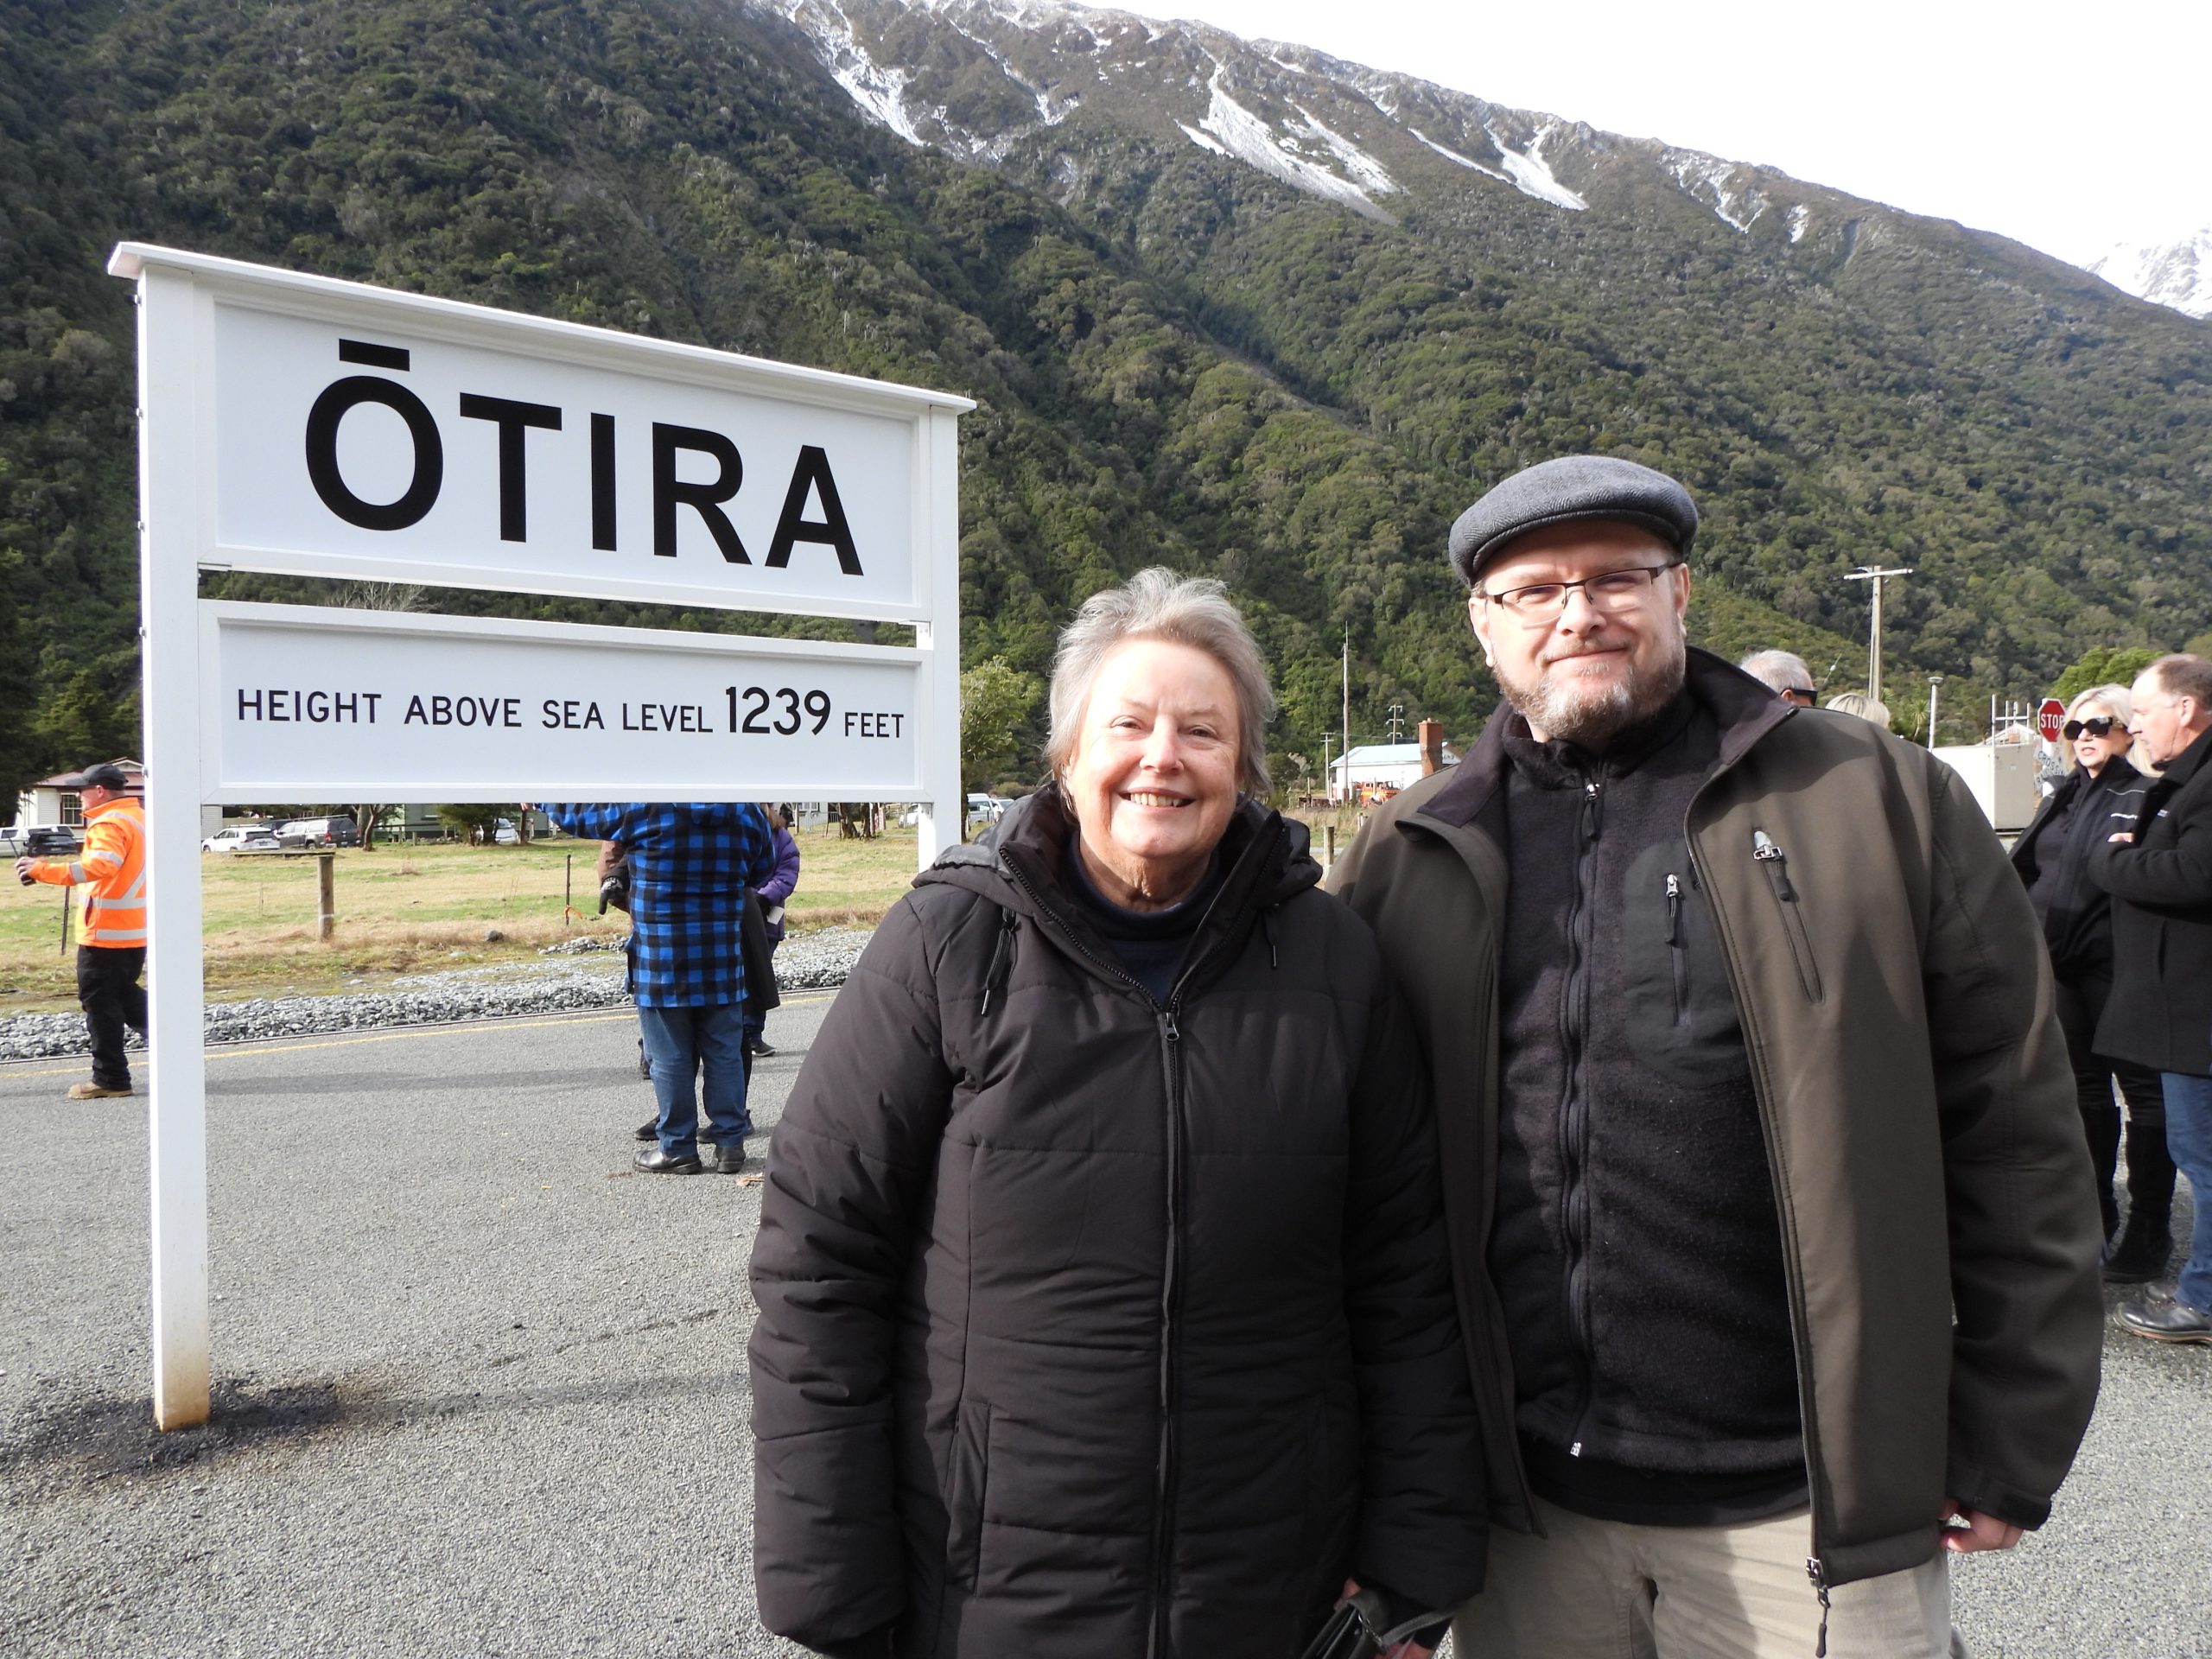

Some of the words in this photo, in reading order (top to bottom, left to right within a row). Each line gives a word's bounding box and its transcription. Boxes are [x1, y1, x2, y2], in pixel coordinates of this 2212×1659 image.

[305, 338, 864, 576] ŌTIRA
[238, 689, 382, 724] HEIGHT
[404, 695, 522, 728] ABOVE
[542, 699, 605, 730] SEA
[622, 702, 714, 733] LEVEL
[725, 686, 831, 736] 1239
[844, 711, 905, 739] FEET
